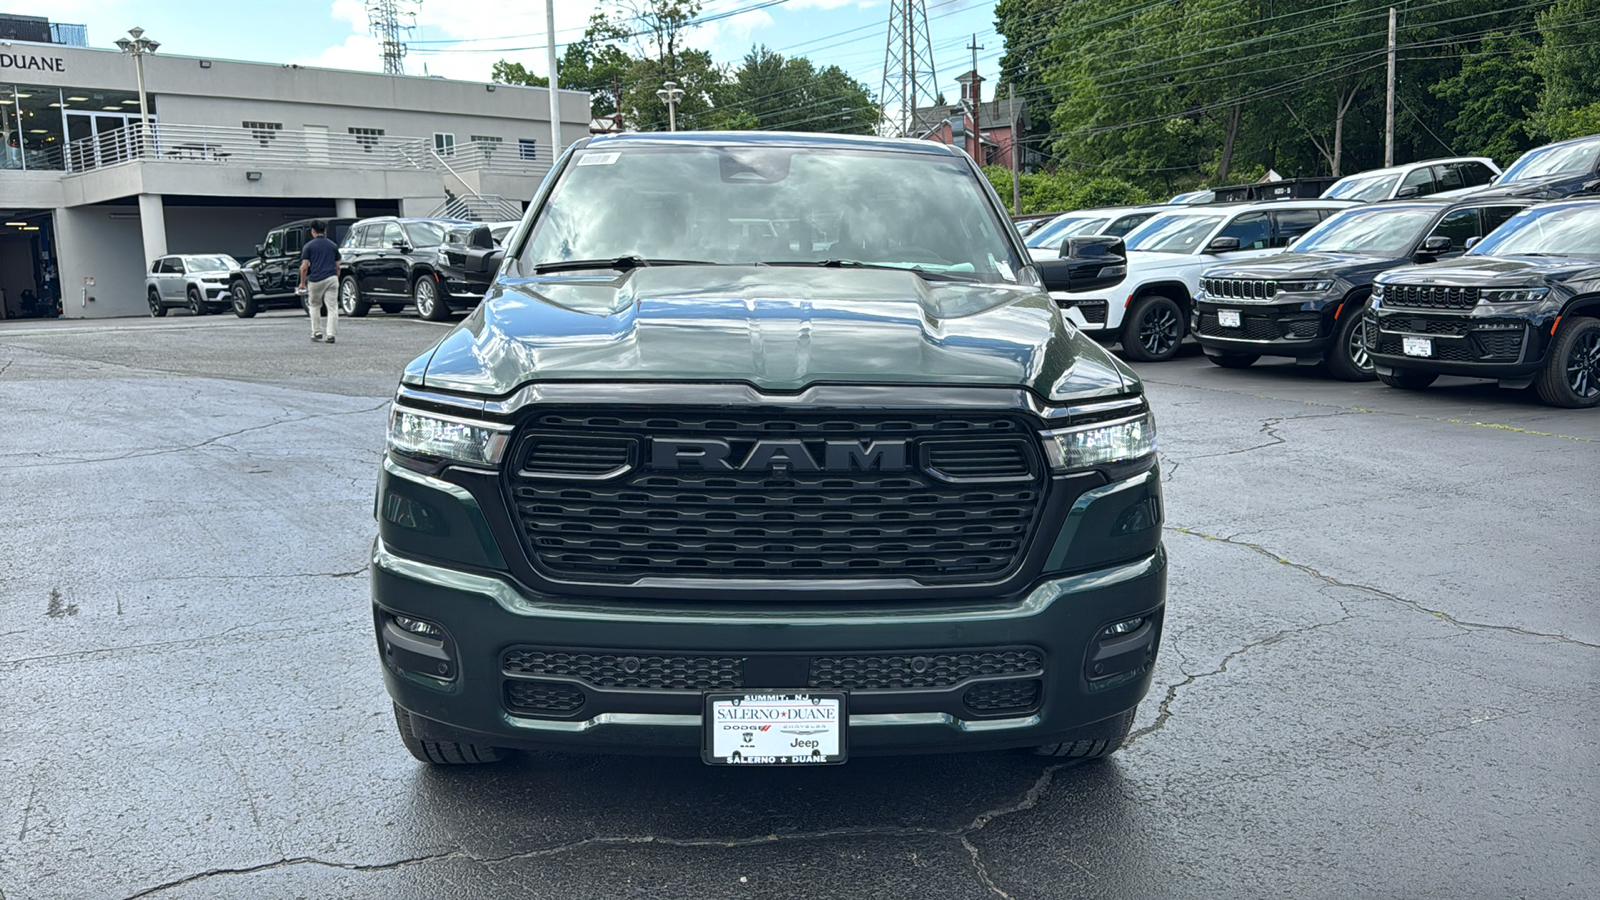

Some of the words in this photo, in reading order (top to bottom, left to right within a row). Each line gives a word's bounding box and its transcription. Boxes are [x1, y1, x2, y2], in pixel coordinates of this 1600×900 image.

[0, 53, 65, 72] DUANE
[652, 437, 906, 471] RAM
[717, 708, 780, 720] SALERNO
[787, 708, 835, 720] DUANE
[790, 737, 819, 749] Jeep
[726, 755, 776, 764] SALERNO
[791, 755, 827, 763] DUANE
